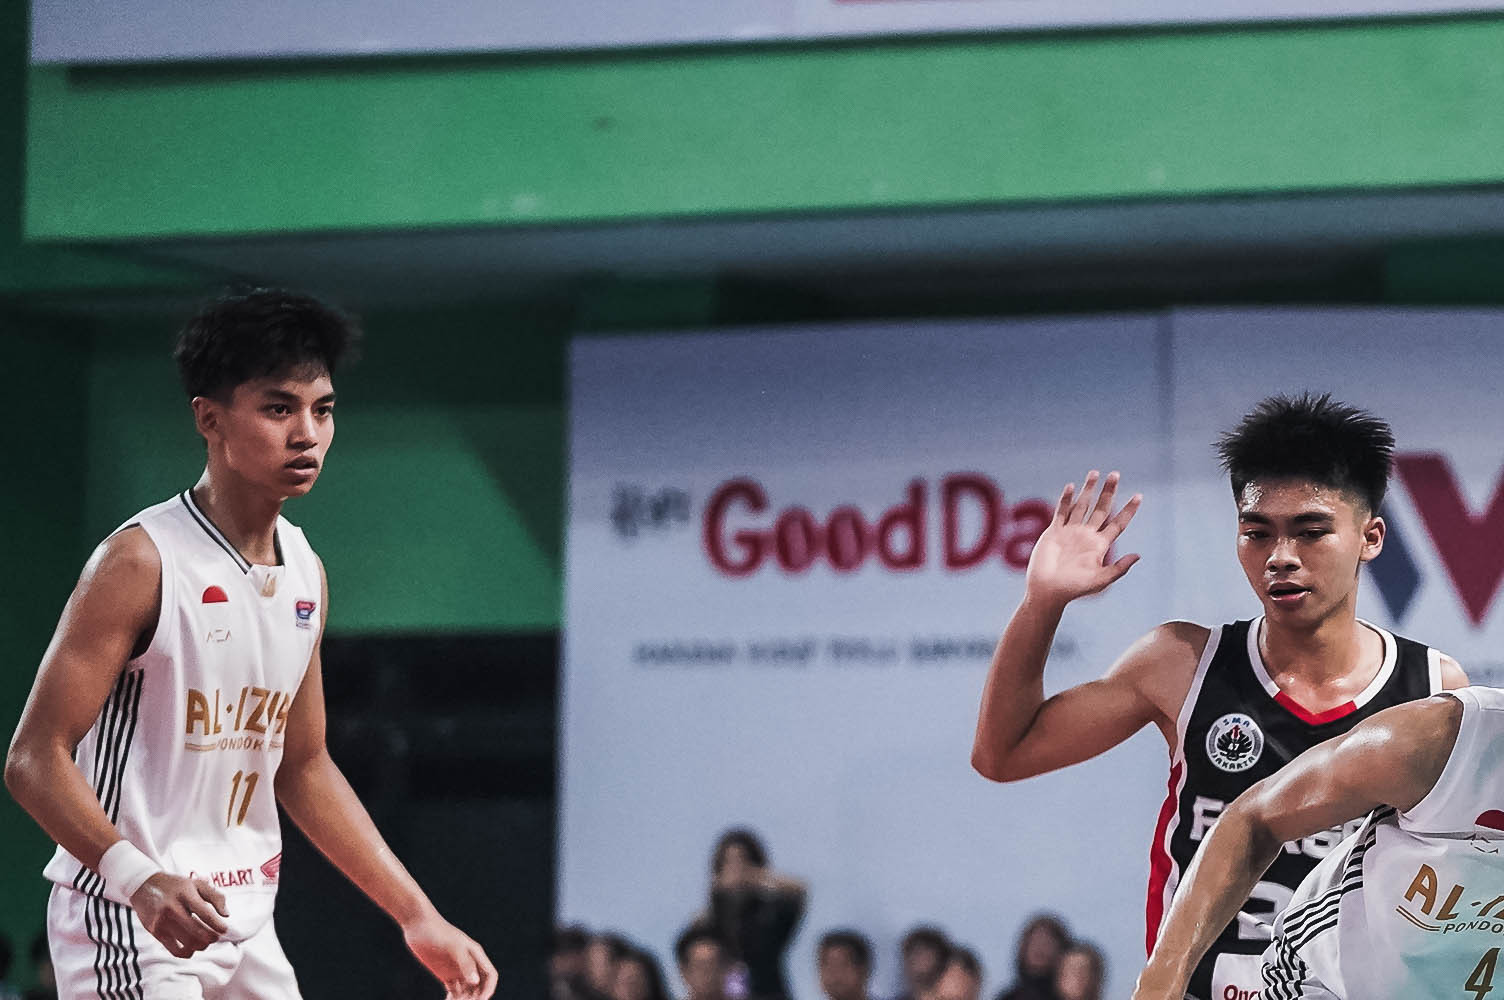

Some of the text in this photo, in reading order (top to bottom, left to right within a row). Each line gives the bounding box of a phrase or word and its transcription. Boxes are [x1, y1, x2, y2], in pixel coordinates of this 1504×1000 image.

[1223, 717, 1250, 728] SMA
[1210, 753, 1256, 770] JAKARTA
[226, 769, 260, 829] 11
